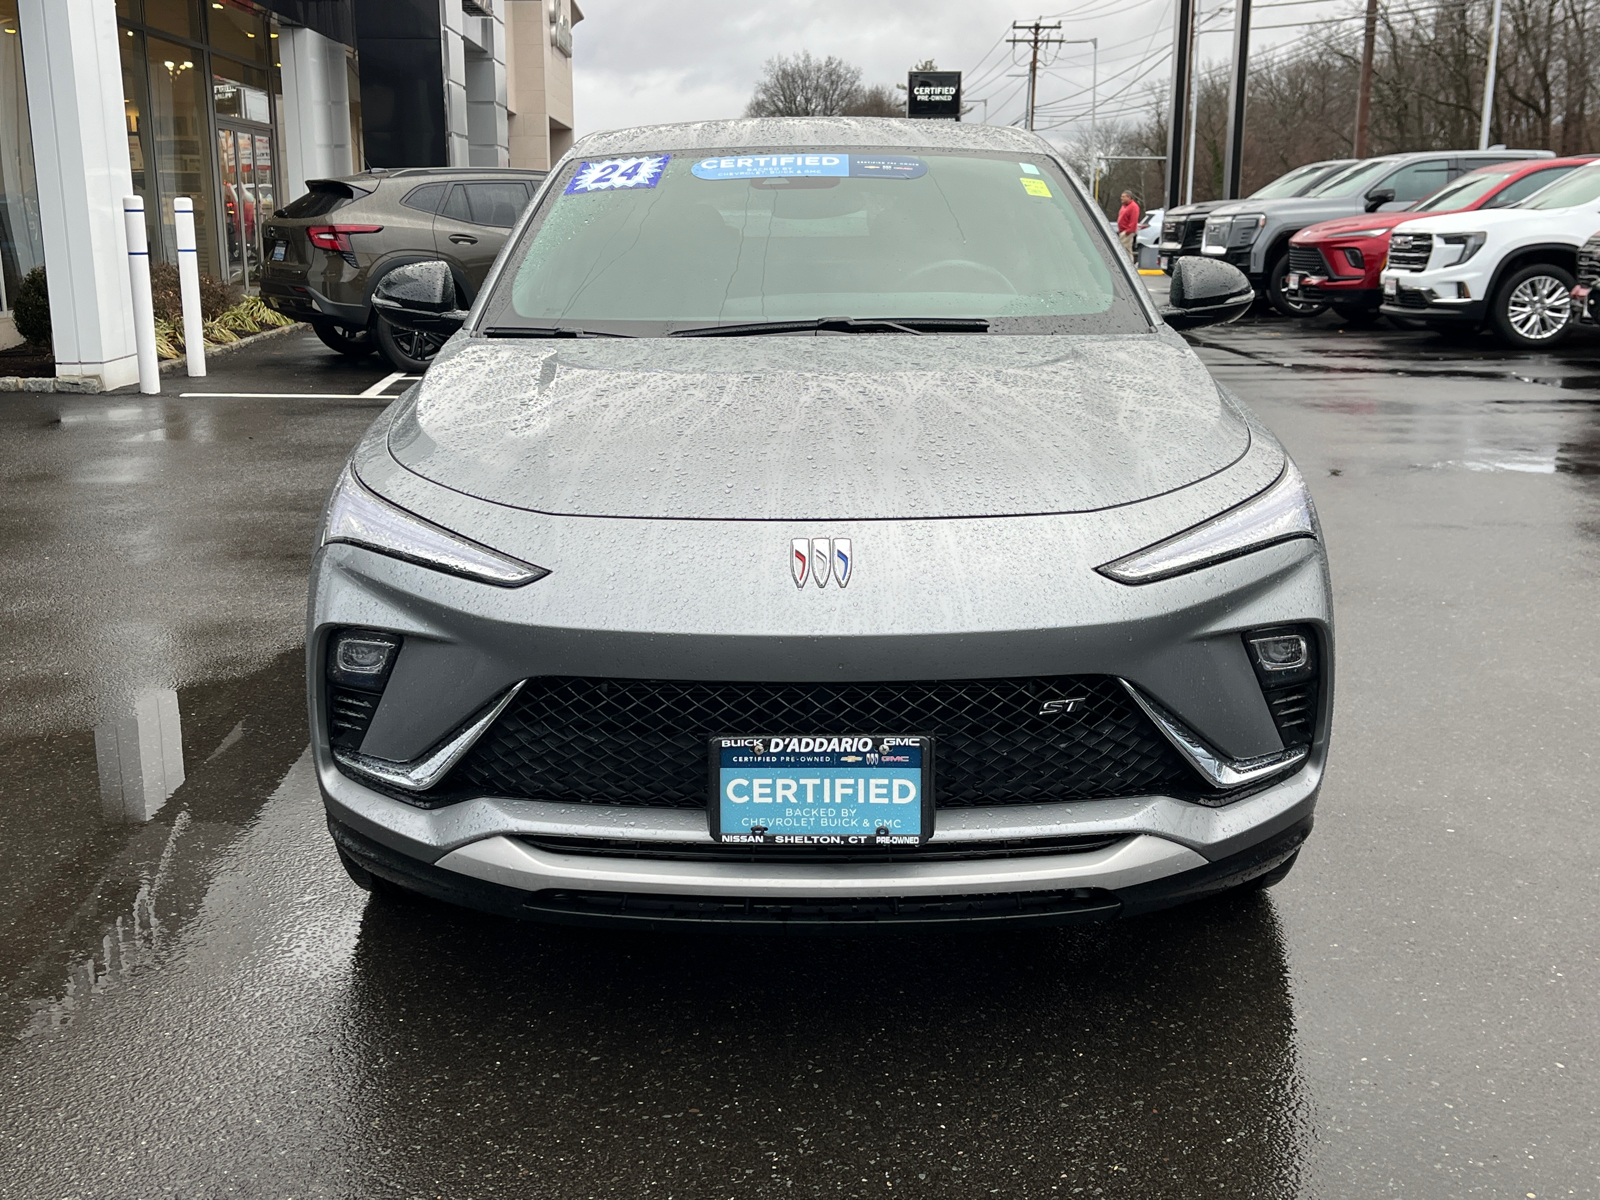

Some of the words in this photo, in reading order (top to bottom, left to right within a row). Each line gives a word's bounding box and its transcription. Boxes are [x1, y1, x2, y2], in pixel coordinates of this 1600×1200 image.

[914, 87, 956, 95] CERTIFIED
[700, 156, 840, 169] CERTIFIED
[591, 162, 643, 184] 24
[1039, 698, 1086, 715] ST
[722, 739, 763, 748] BUICK
[770, 738, 873, 753] D'ADDARIO
[884, 738, 920, 746] GMC
[726, 778, 917, 804] CERTIFIED
[785, 808, 836, 817] BACKED
[841, 808, 857, 817] BY
[741, 817, 815, 827] CHEVROLET
[821, 818, 858, 827] BUICK
[862, 818, 870, 827] &
[874, 819, 901, 828] GMC
[721, 835, 764, 843] NISSAN
[775, 835, 844, 844] SHELTON,
[848, 836, 867, 844] CT
[876, 836, 919, 844] PRE-OWNED
